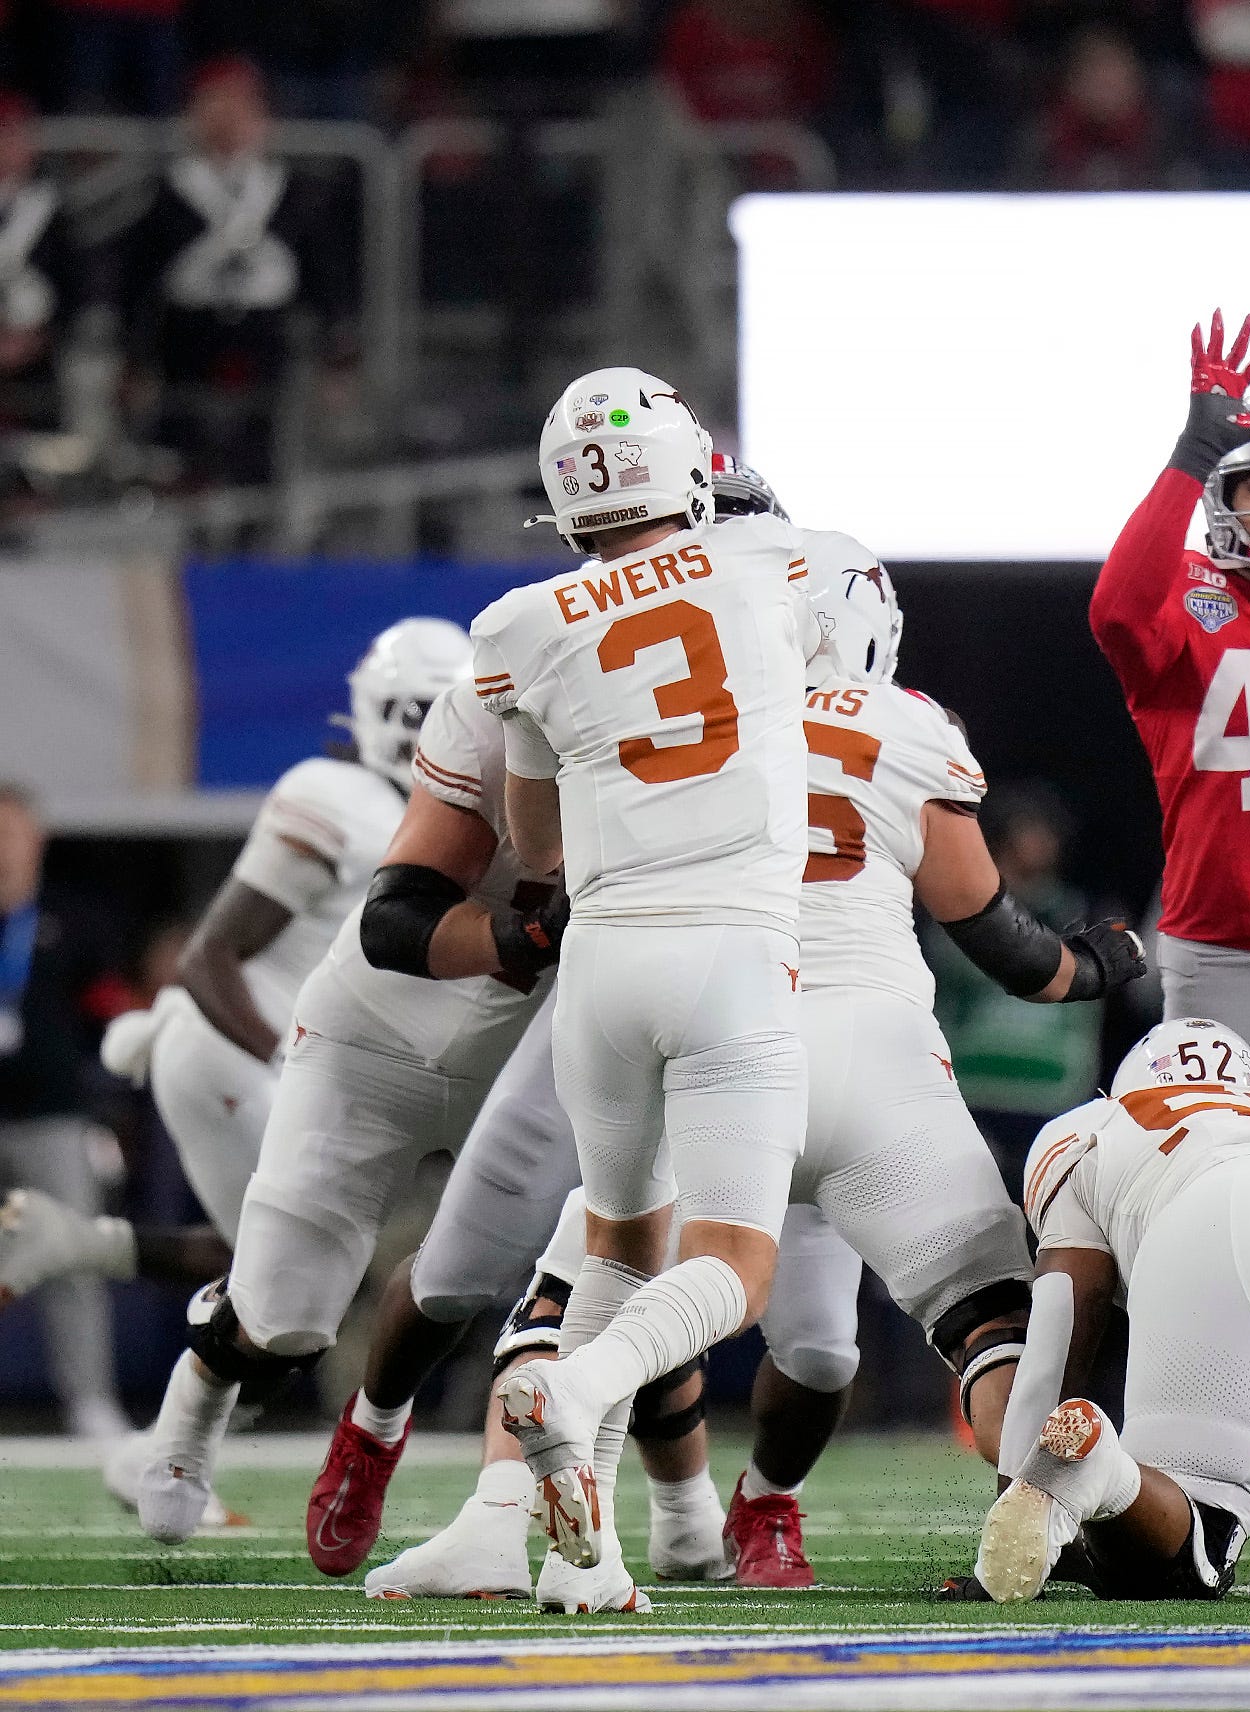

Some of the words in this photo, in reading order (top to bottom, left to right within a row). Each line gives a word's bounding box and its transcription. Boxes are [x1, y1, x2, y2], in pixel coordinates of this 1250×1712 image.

[611, 413, 629, 422] C2P
[582, 443, 610, 493] 3
[554, 544, 713, 625] EWERS
[597, 598, 740, 785] 3
[1178, 1040, 1237, 1083] 52
